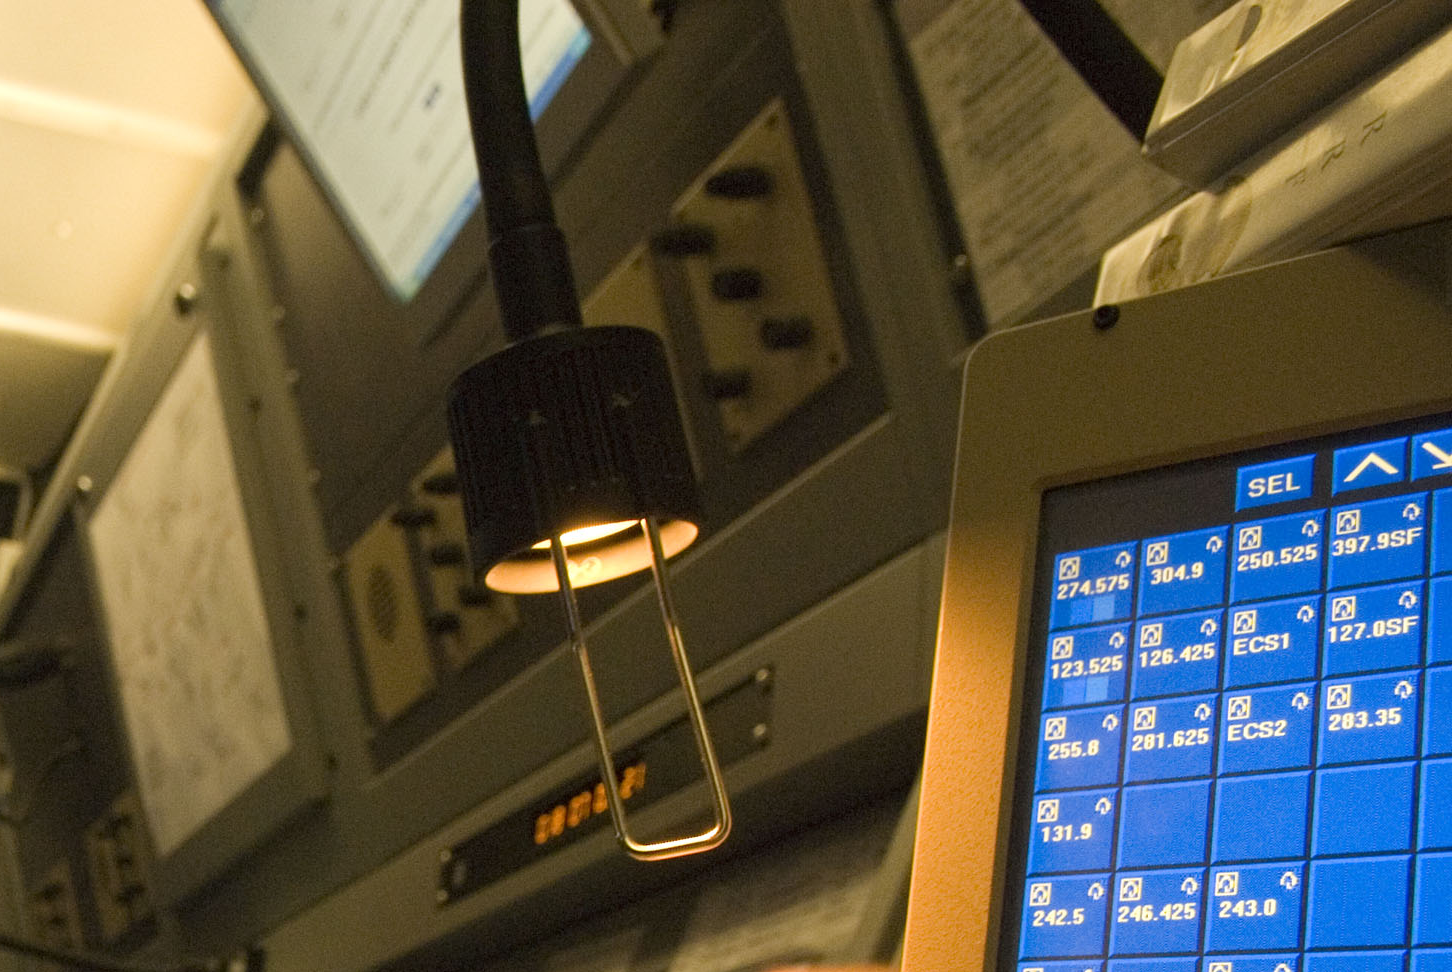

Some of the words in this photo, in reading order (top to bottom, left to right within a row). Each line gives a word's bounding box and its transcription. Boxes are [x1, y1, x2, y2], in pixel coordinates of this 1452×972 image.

[1249, 473, 1300, 497] SEL
[1332, 527, 1423, 556] 397.9SF
[1238, 543, 1318, 571] 250.525
[1151, 562, 1204, 585] 304.9
[1057, 574, 1129, 600] 274.575
[1328, 615, 1419, 643] 127.0SF
[1140, 642, 1215, 668] 126.425
[1233, 633, 1290, 655] ECS1
[1051, 655, 1123, 679] 123.525
[1228, 719, 1287, 742] ECS2
[1328, 707, 1402, 732] 283.35
[1132, 728, 1210, 752] 281.625
[1041, 823, 1093, 842] 131.9
[1033, 908, 1084, 926] 242.5
[1118, 903, 1196, 923] 246.425
[1219, 899, 1276, 918] 243.0
